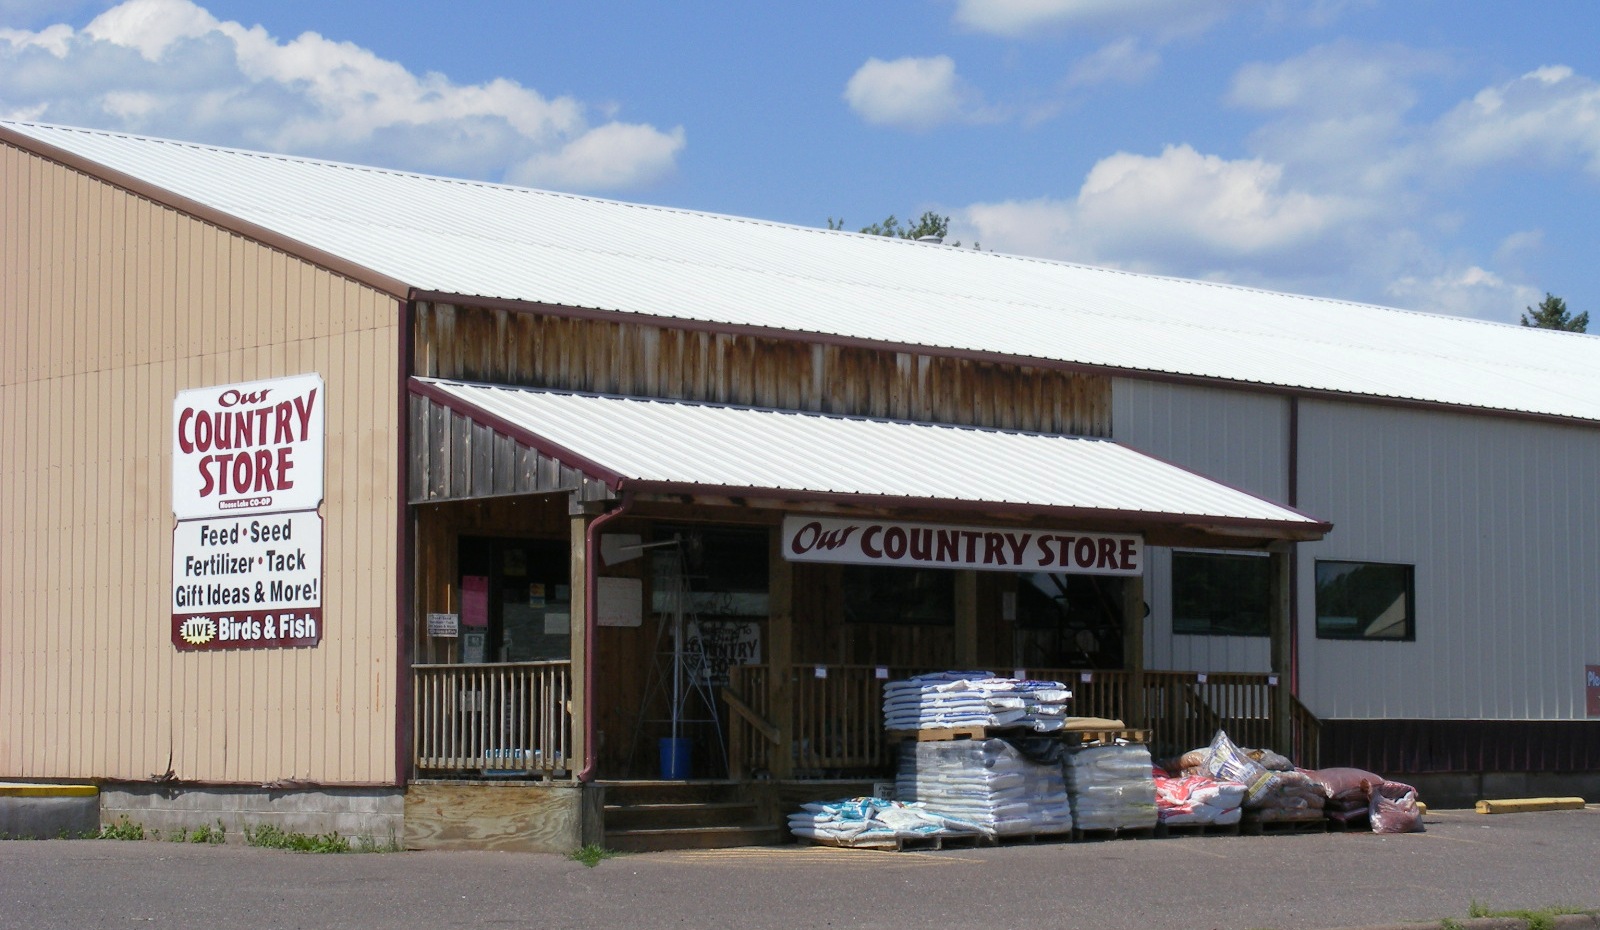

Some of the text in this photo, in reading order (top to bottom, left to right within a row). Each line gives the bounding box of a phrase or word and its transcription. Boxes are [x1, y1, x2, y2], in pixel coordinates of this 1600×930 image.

[218, 389, 274, 408] Our
[178, 387, 317, 454] COUNTRY
[198, 447, 294, 497] STORE
[250, 497, 271, 507] CO-OP
[201, 519, 292, 546] Feed Seed
[791, 521, 1137, 570] Our COUNTRY STORE
[185, 548, 306, 577] Fertilizer Tack
[176, 578, 317, 607] Gift Ideas & More!
[186, 613, 316, 641] LIVE Birds & Fish
[688, 654, 747, 673] STO
